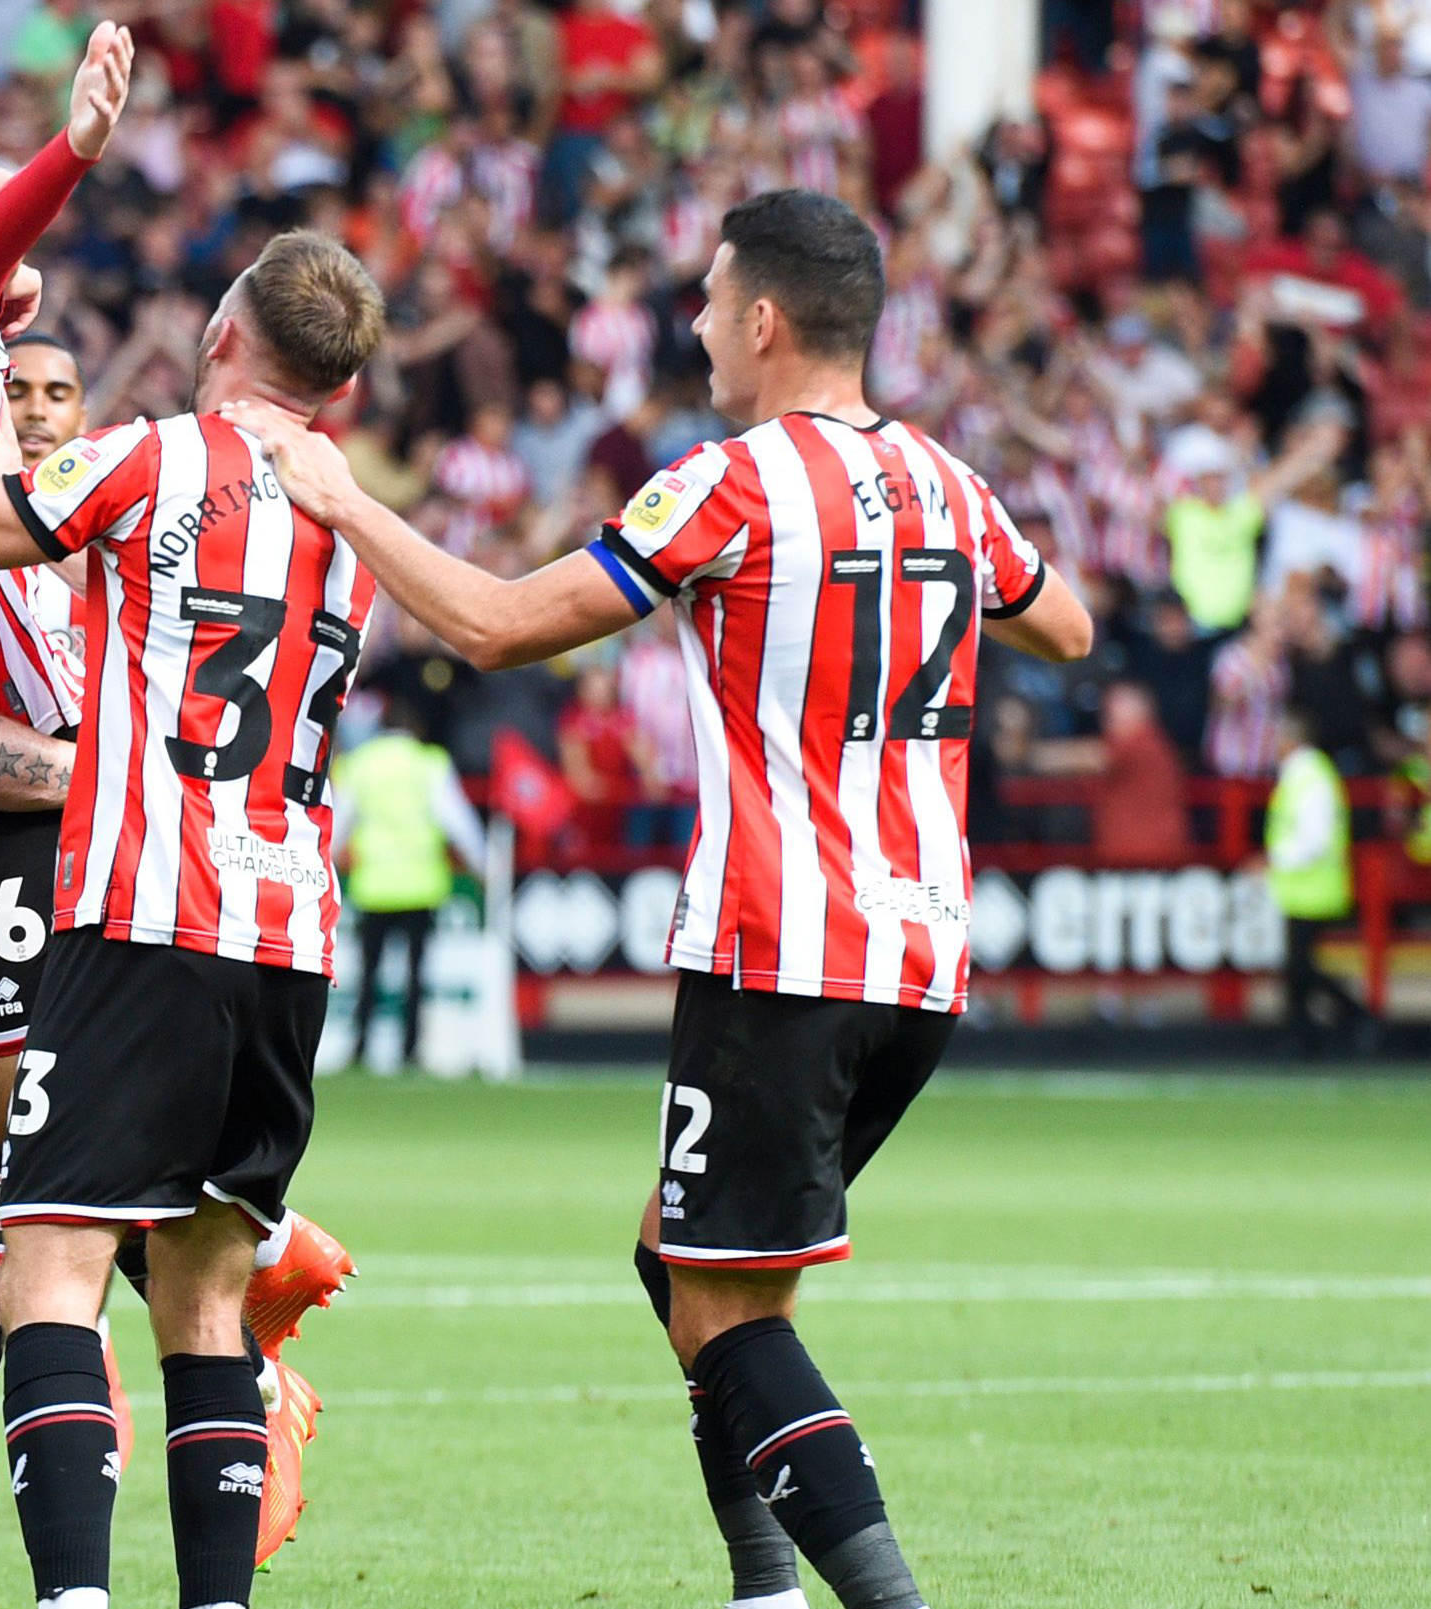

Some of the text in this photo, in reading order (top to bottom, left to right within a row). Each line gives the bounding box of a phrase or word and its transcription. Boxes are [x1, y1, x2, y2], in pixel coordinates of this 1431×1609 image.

[850, 471, 948, 521] EGAN
[830, 548, 974, 742] 12
[164, 586, 361, 807] 33
[7, 1049, 57, 1136] 3
[660, 1081, 712, 1174] 12
